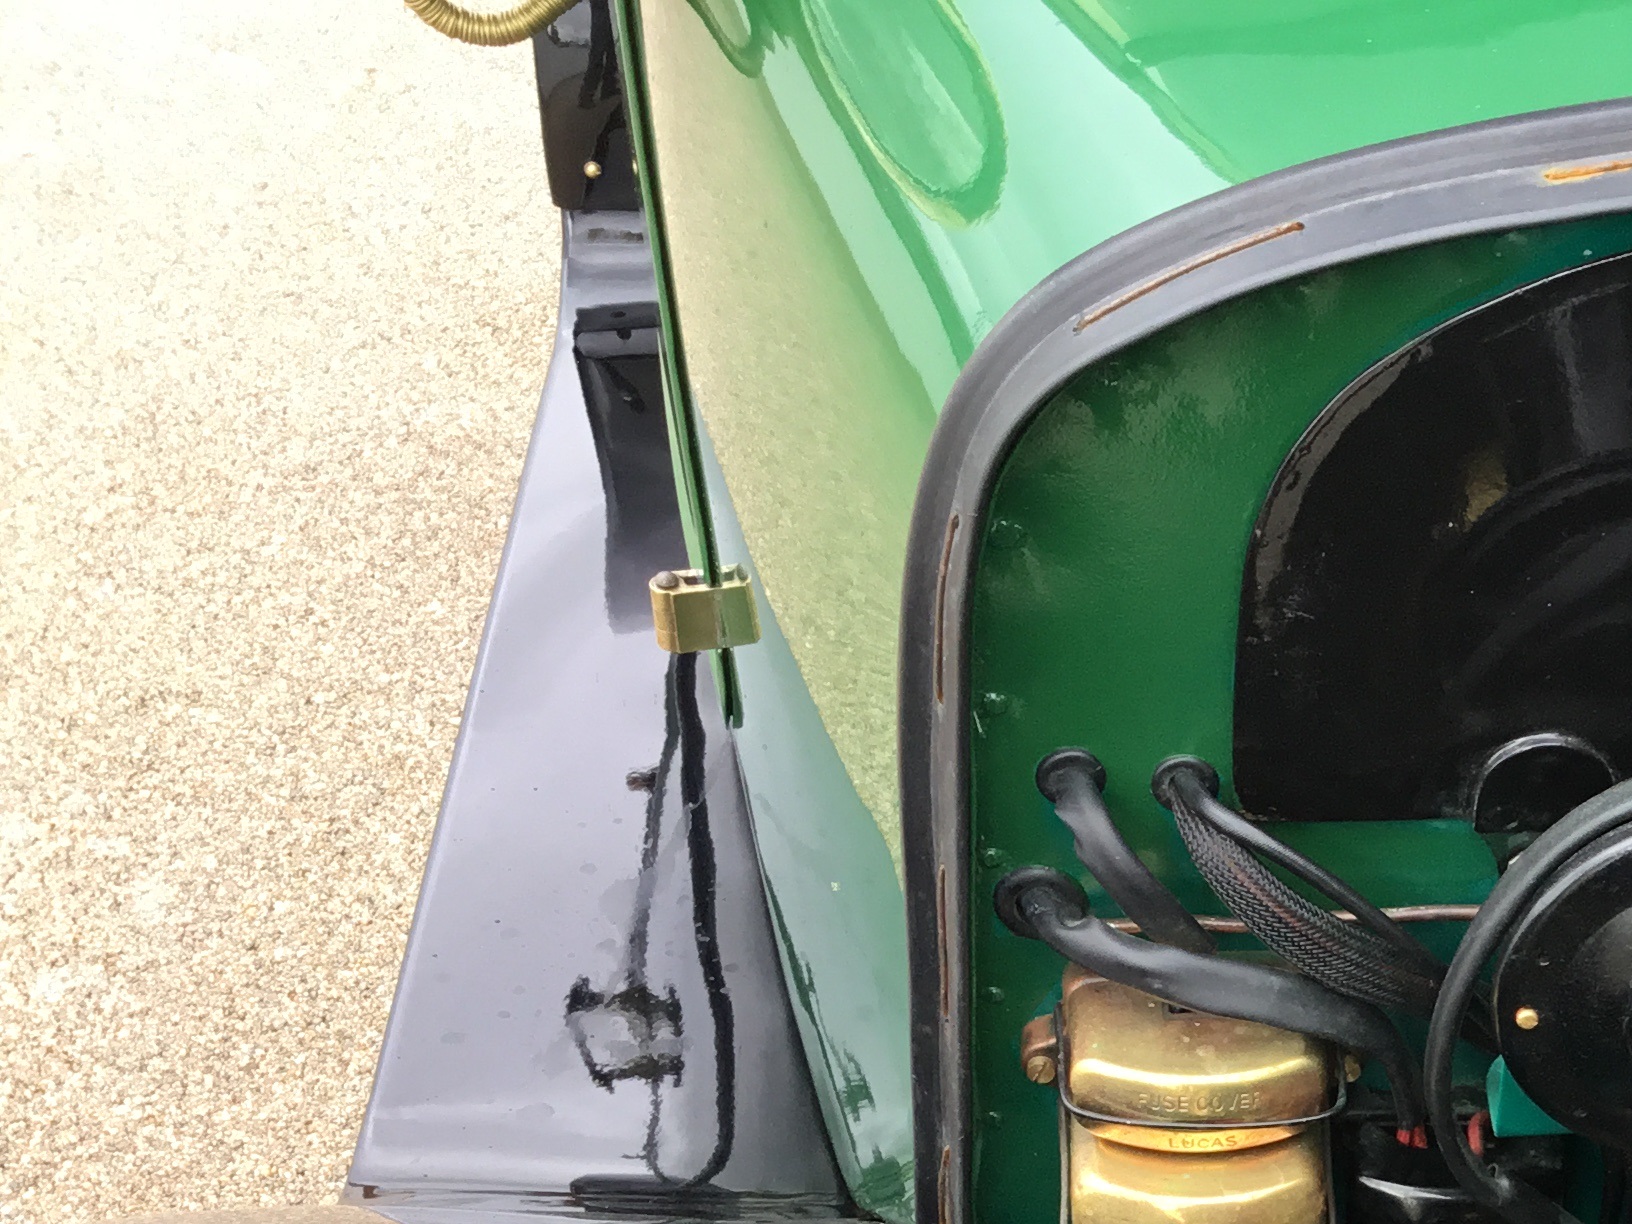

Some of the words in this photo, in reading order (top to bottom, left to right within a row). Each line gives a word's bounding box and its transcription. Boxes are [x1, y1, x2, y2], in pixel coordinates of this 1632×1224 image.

[1138, 1092, 1189, 1114] FUSE
[1195, 1090, 1261, 1115] COVER
[1168, 1134, 1239, 1149] LUCAS
